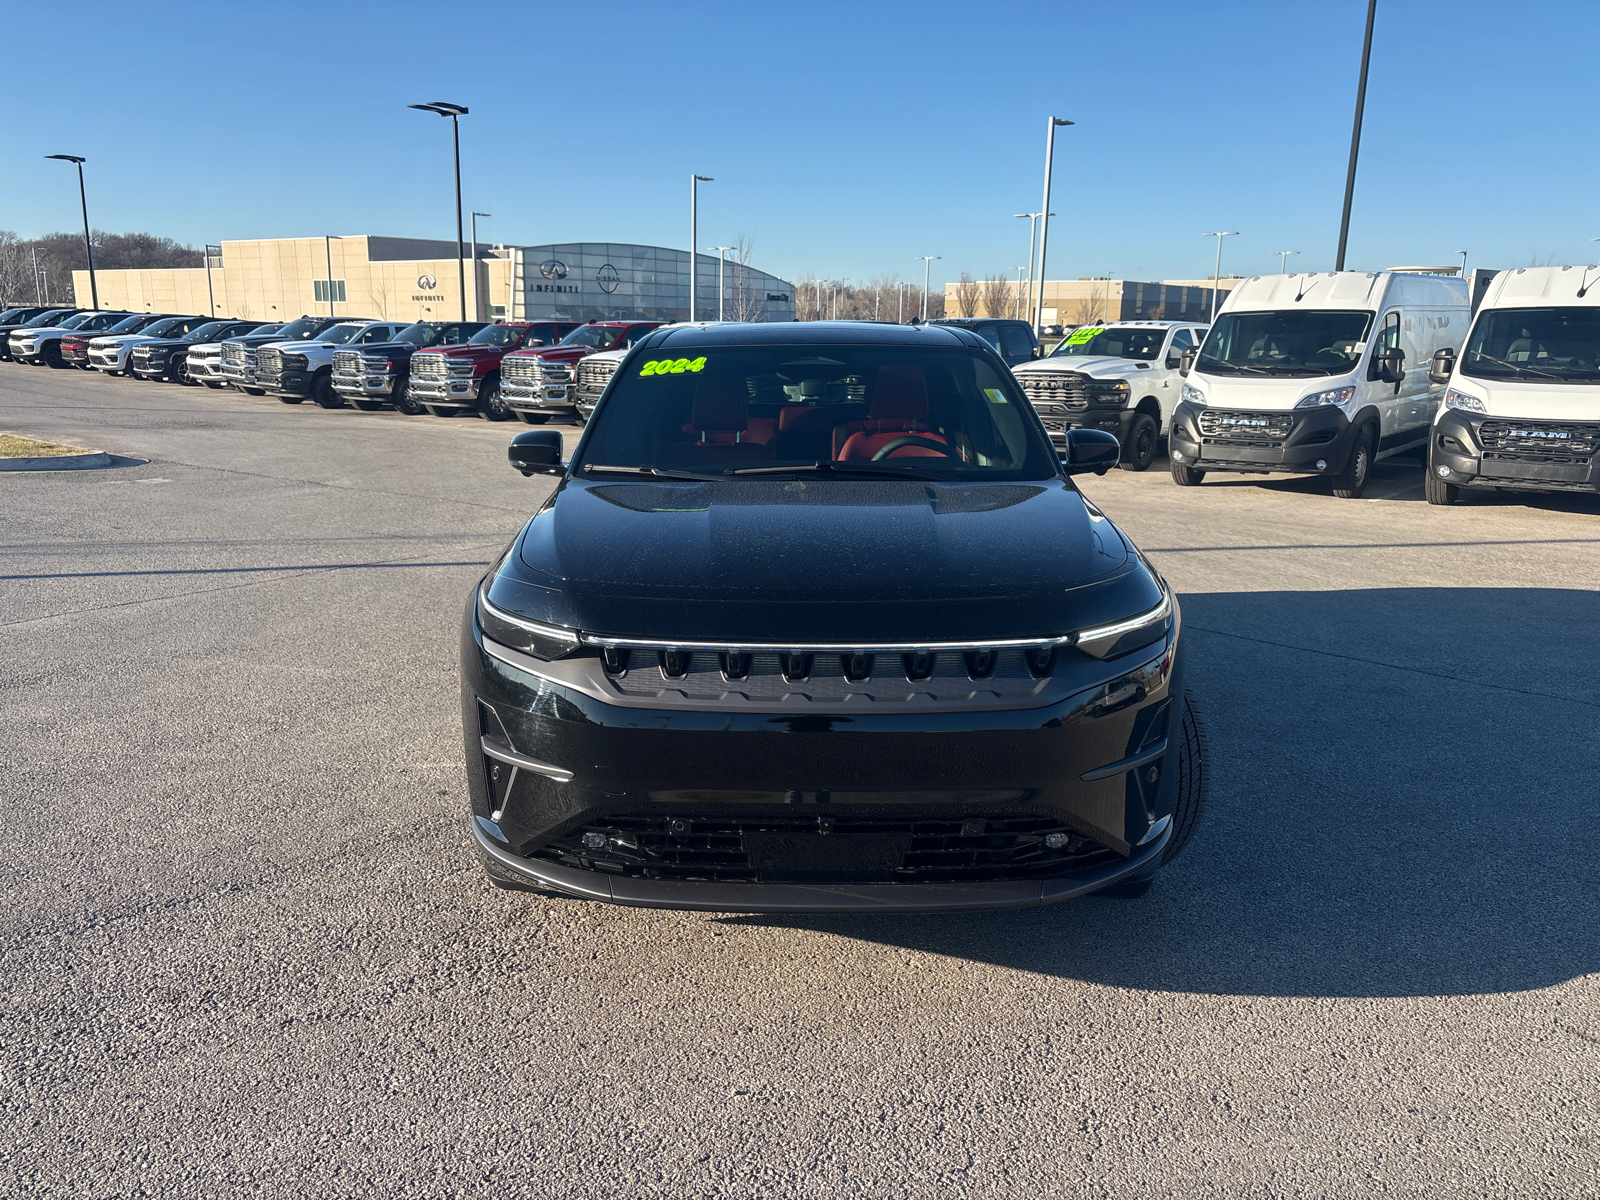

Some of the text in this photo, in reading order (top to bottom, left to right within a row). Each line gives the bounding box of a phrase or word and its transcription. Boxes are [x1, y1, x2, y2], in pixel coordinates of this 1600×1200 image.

[595, 275, 621, 283] NISSAN
[530, 284, 579, 294] INFINITI
[639, 356, 708, 377] 2024
[1024, 380, 1064, 389] RAM
[1222, 418, 1267, 427] RAM
[1509, 430, 1567, 438] RAM
